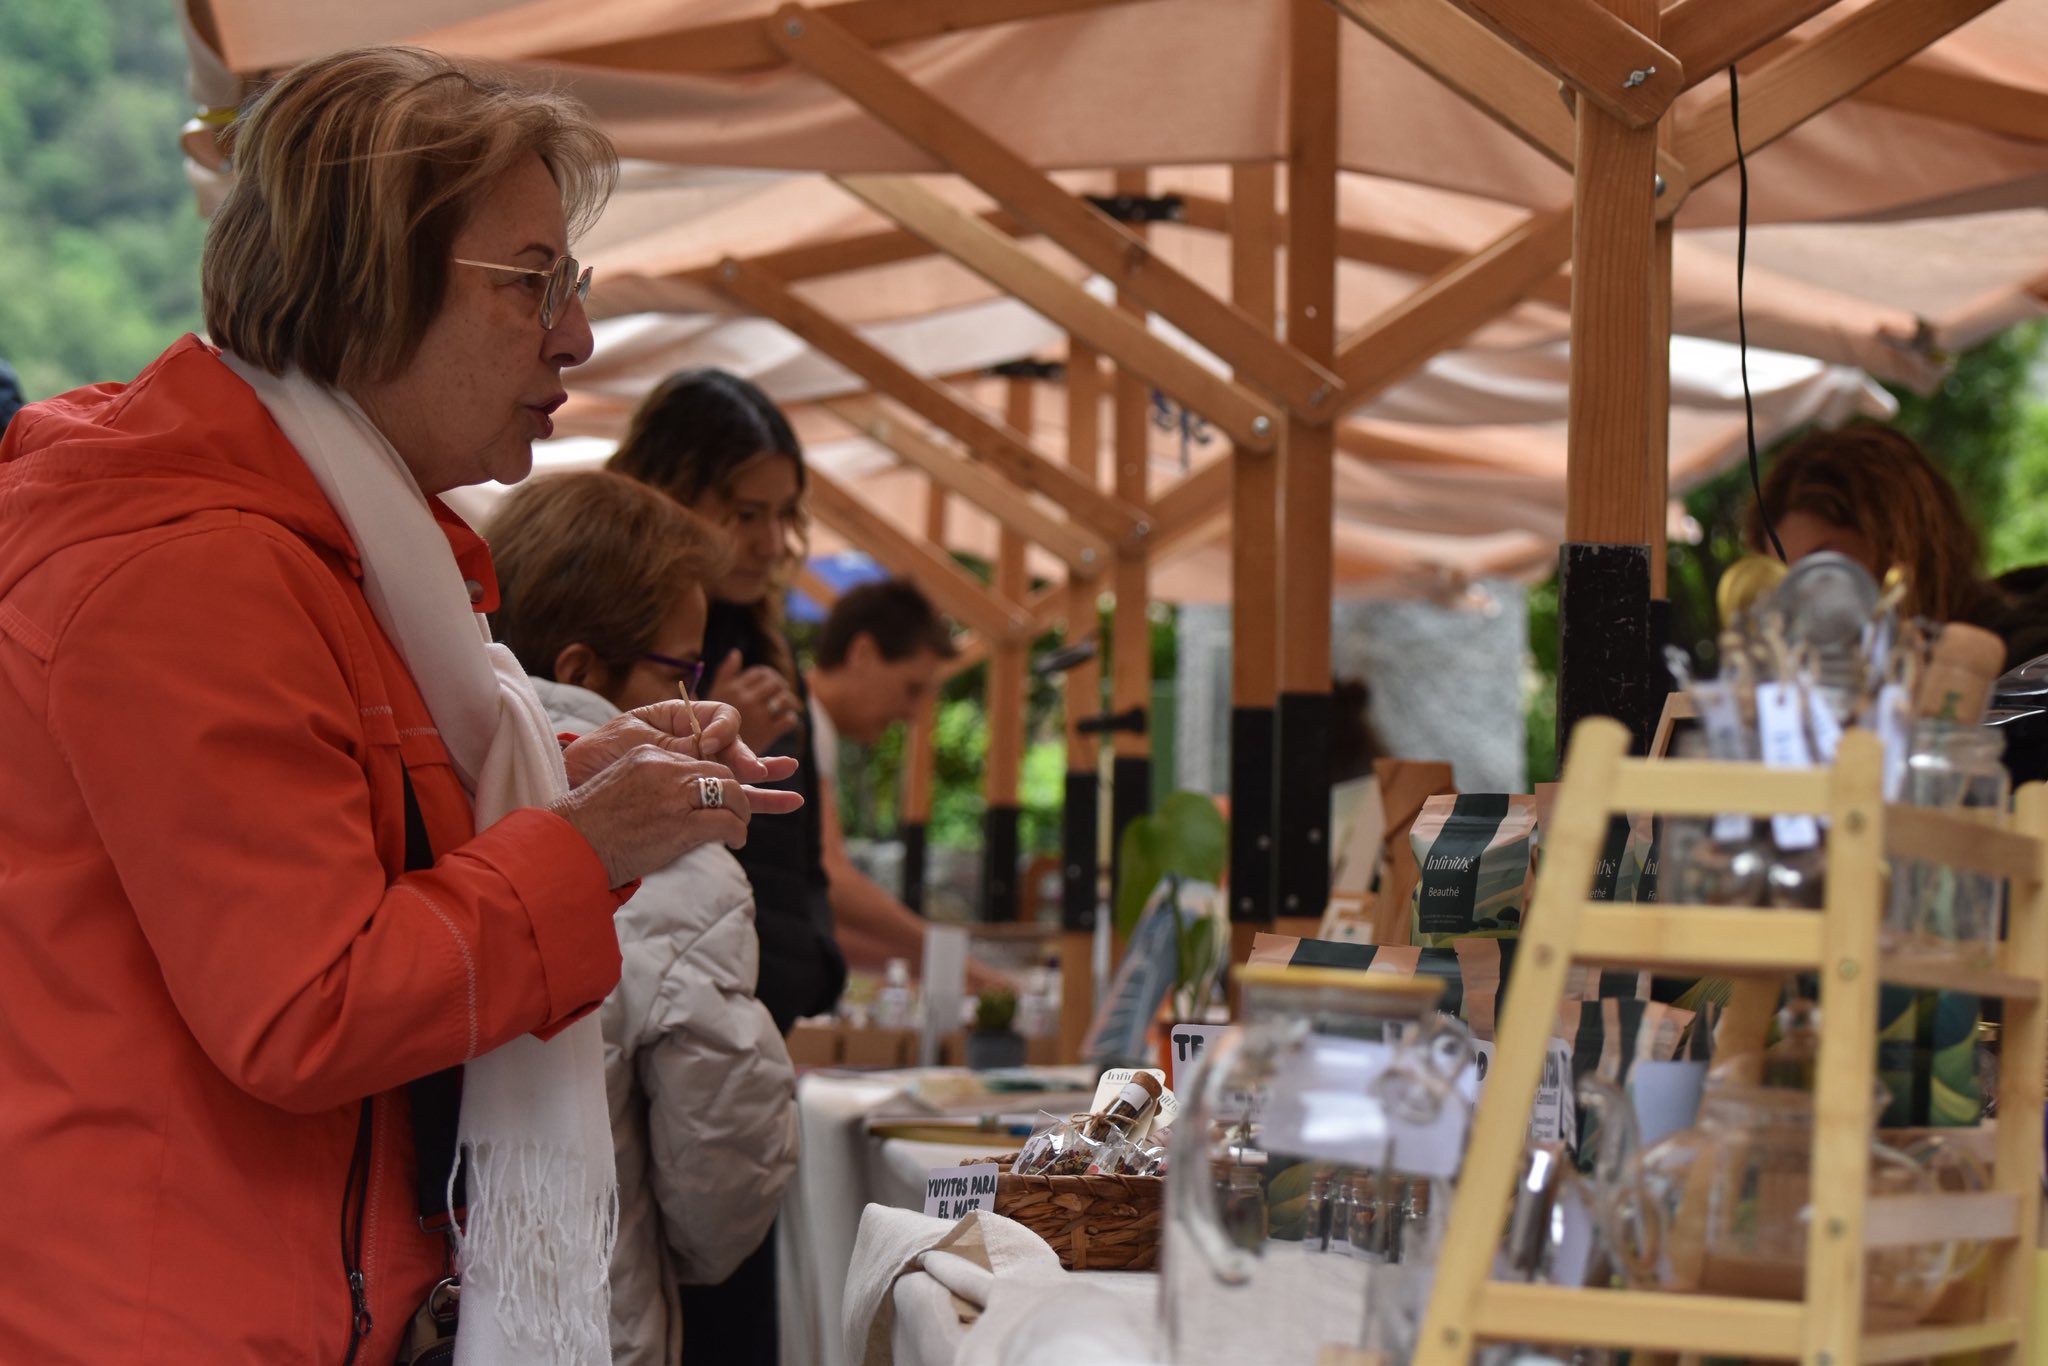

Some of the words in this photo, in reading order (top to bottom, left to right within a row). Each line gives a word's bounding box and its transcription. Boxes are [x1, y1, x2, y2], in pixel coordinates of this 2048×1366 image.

[1428, 886, 1460, 897] Beauthé
[928, 1177, 968, 1198] YUYITOS
[970, 1174, 995, 1195] PARA
[938, 1200, 949, 1219] EL
